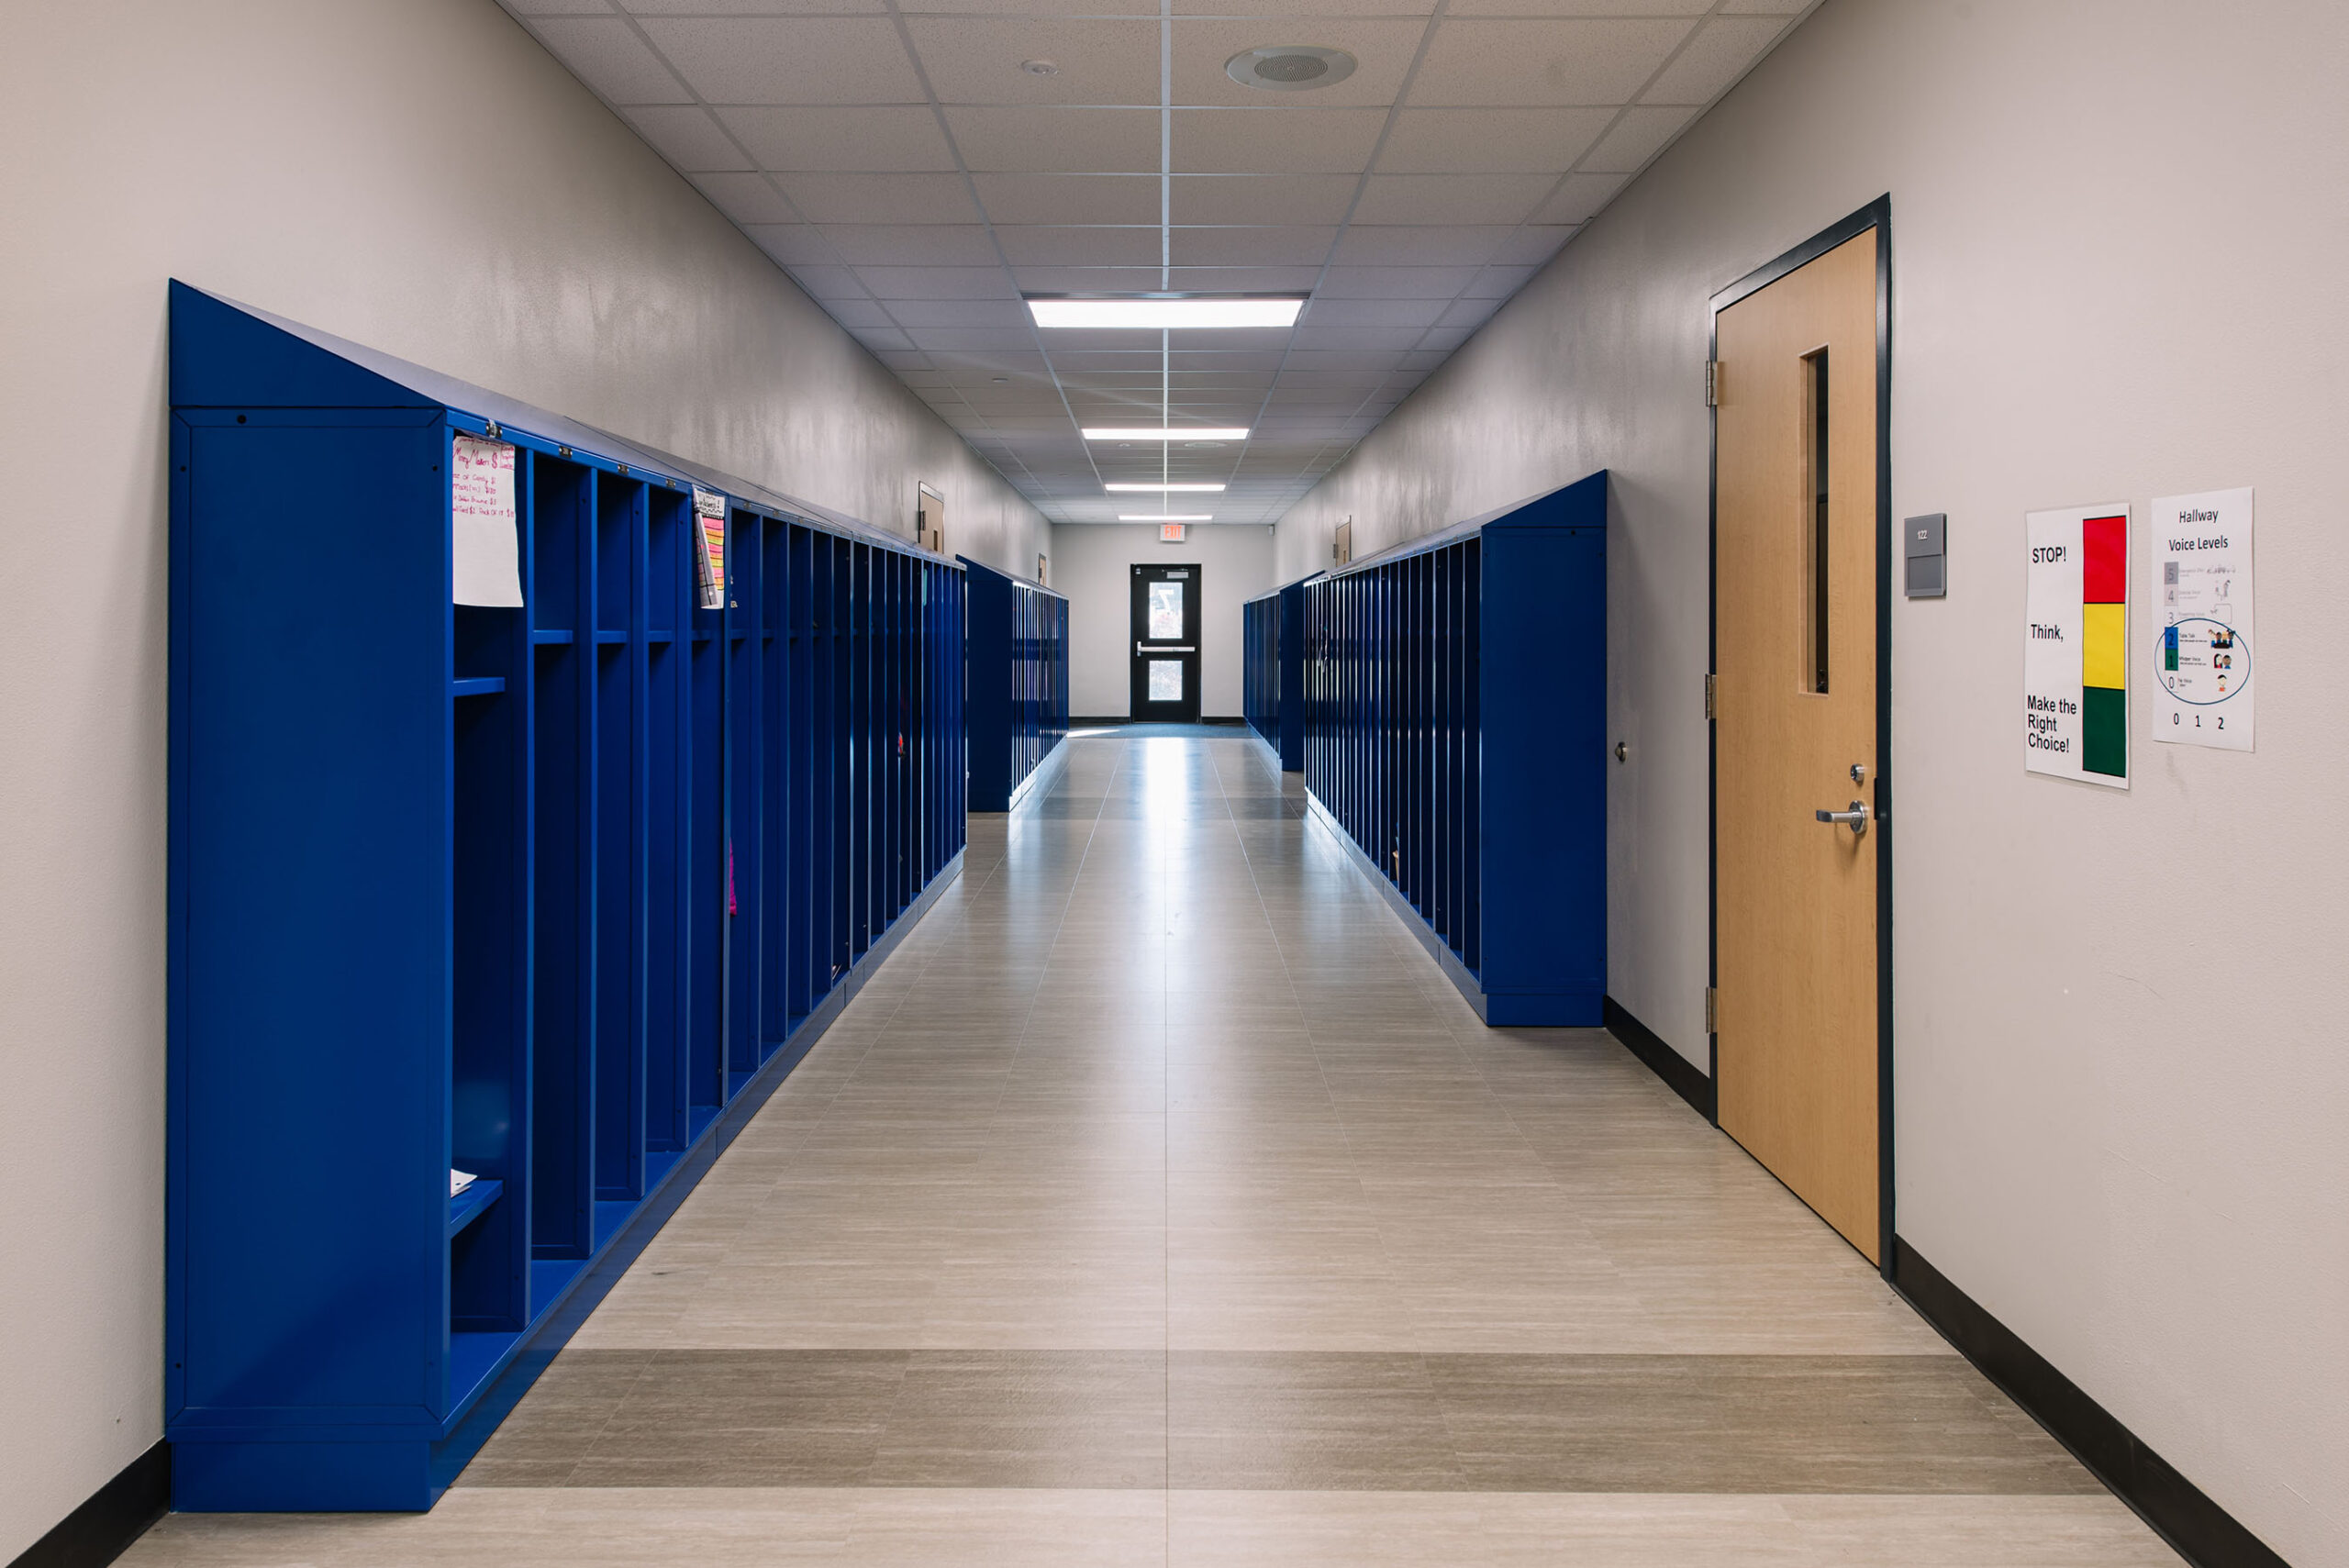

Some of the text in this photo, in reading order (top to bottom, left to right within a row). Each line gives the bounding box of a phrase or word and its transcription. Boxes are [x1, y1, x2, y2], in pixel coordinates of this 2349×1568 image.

[2179, 508, 2219, 524] Hallway
[1164, 525, 1182, 539] EXIT
[1917, 529, 1928, 539] 122
[2168, 535, 2229, 551] Voice Levels
[2032, 546, 2066, 563] STOP!
[2167, 590, 2175, 602] 4
[2169, 611, 2175, 625] 3
[2031, 624, 2064, 643] Think,
[2168, 633, 2175, 646] 2
[2027, 695, 2076, 715] Make the
[2028, 714, 2057, 734] Right
[2173, 713, 2224, 730] 0 1 2
[2028, 732, 2069, 753] Choice!
